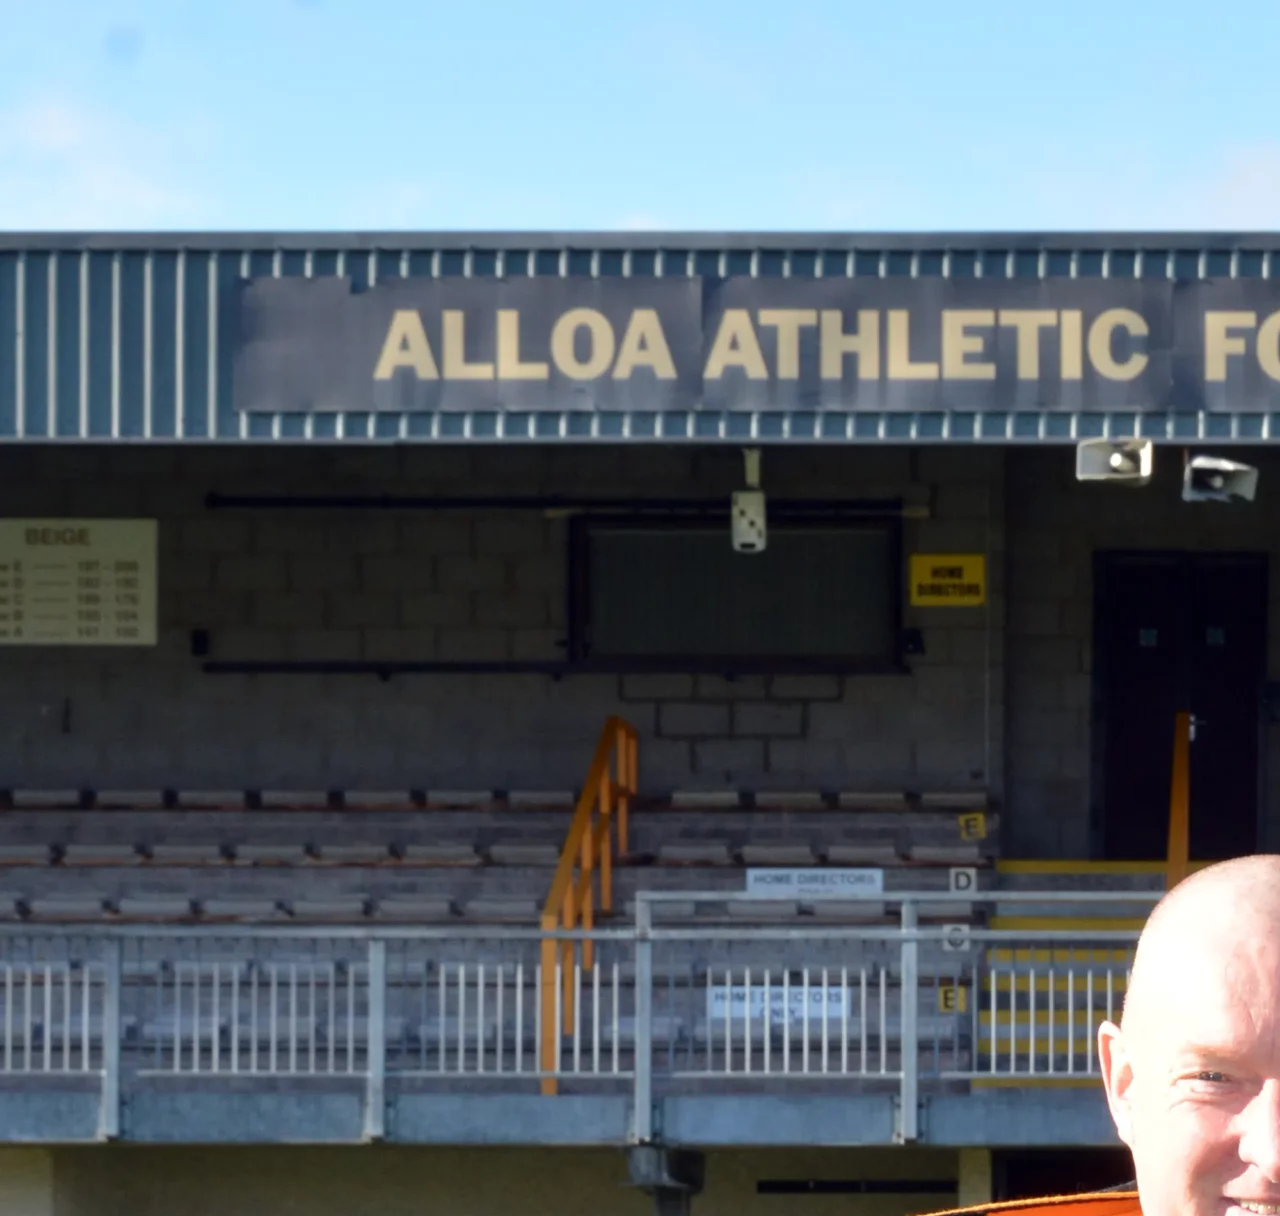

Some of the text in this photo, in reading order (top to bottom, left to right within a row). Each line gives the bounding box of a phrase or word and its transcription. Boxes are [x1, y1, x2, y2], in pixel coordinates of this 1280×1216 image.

[373, 308, 677, 382] ALLOA
[704, 308, 1148, 382] ATHLETIC
[25, 528, 90, 546] BEIGE
[964, 817, 979, 837] E
[753, 873, 876, 885] HOME DIRECTORS
[953, 871, 972, 892] D
[758, 1006, 797, 1019] ONY
